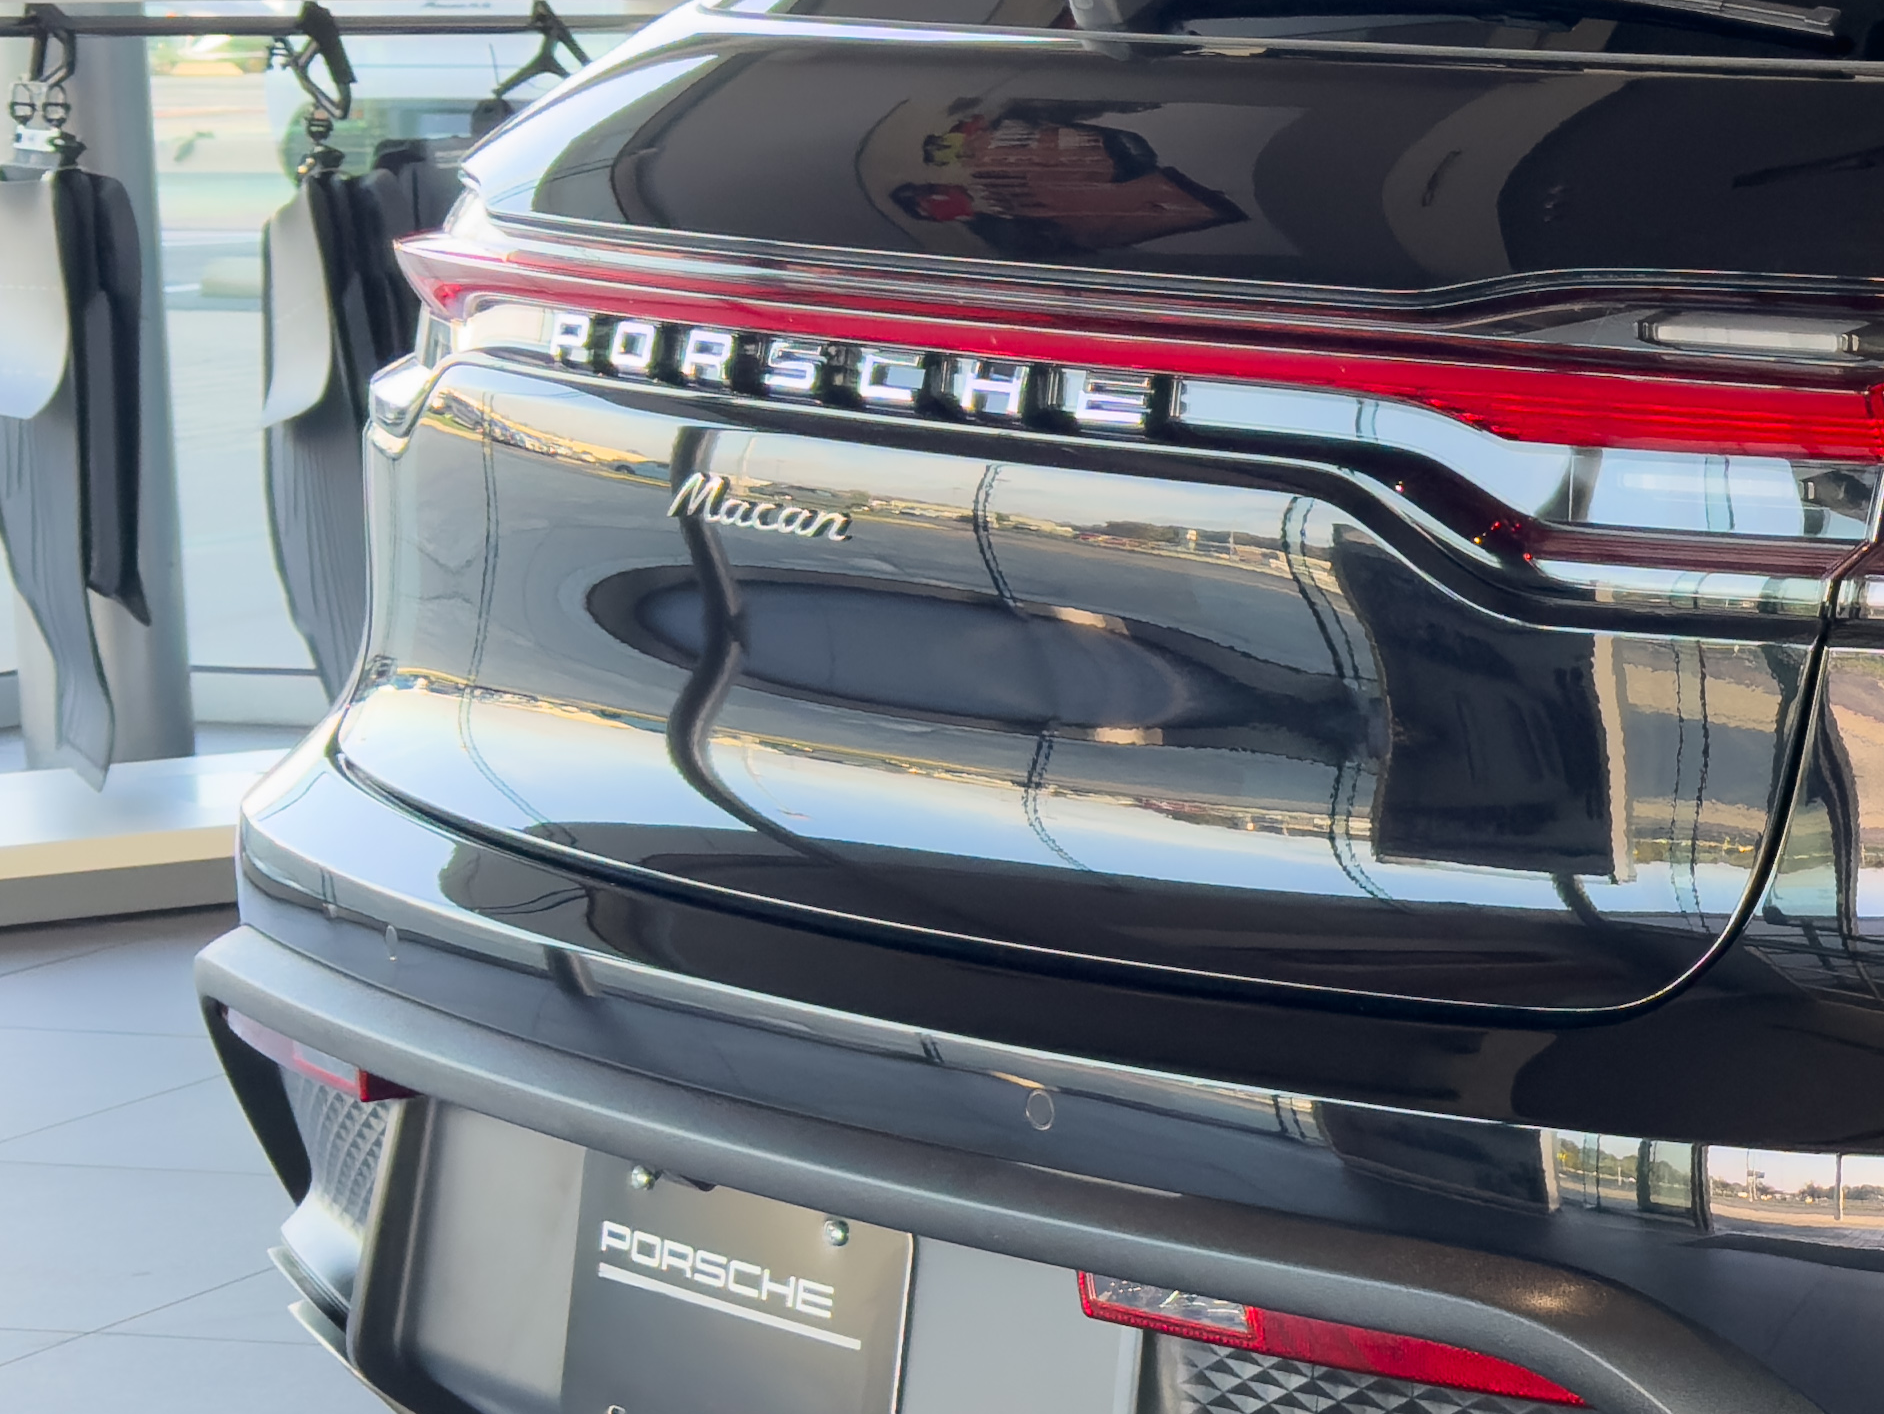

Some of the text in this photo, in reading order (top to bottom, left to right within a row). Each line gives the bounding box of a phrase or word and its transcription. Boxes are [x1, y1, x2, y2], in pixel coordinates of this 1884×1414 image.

[550, 312, 1152, 427] PORSCHE
[667, 472, 852, 542] Macan
[600, 1220, 834, 1319] PORSCHE
